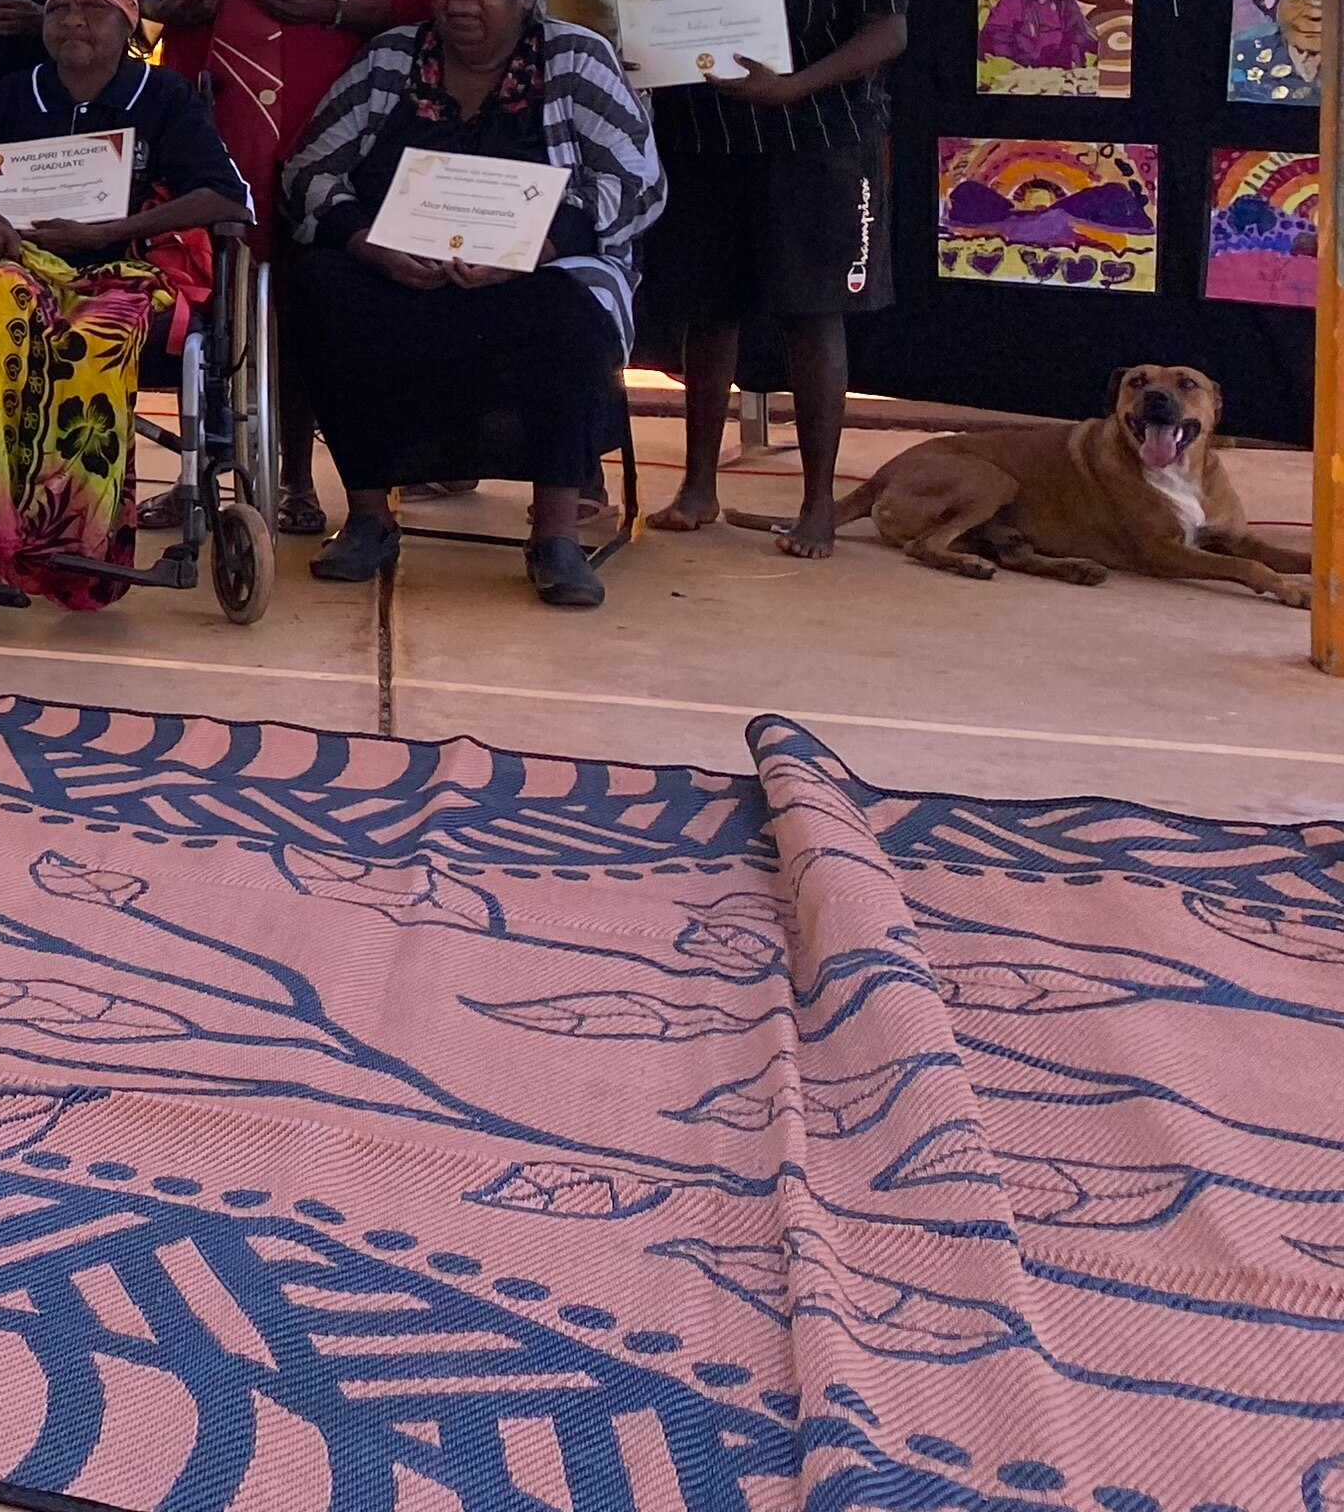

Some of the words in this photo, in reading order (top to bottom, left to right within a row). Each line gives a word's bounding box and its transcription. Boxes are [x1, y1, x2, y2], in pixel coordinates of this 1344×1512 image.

[10, 151, 58, 164] WARLPIRI
[61, 145, 108, 158] TEACHER
[30, 159, 85, 173] GRADUATE
[847, 176, 875, 293] Champion
